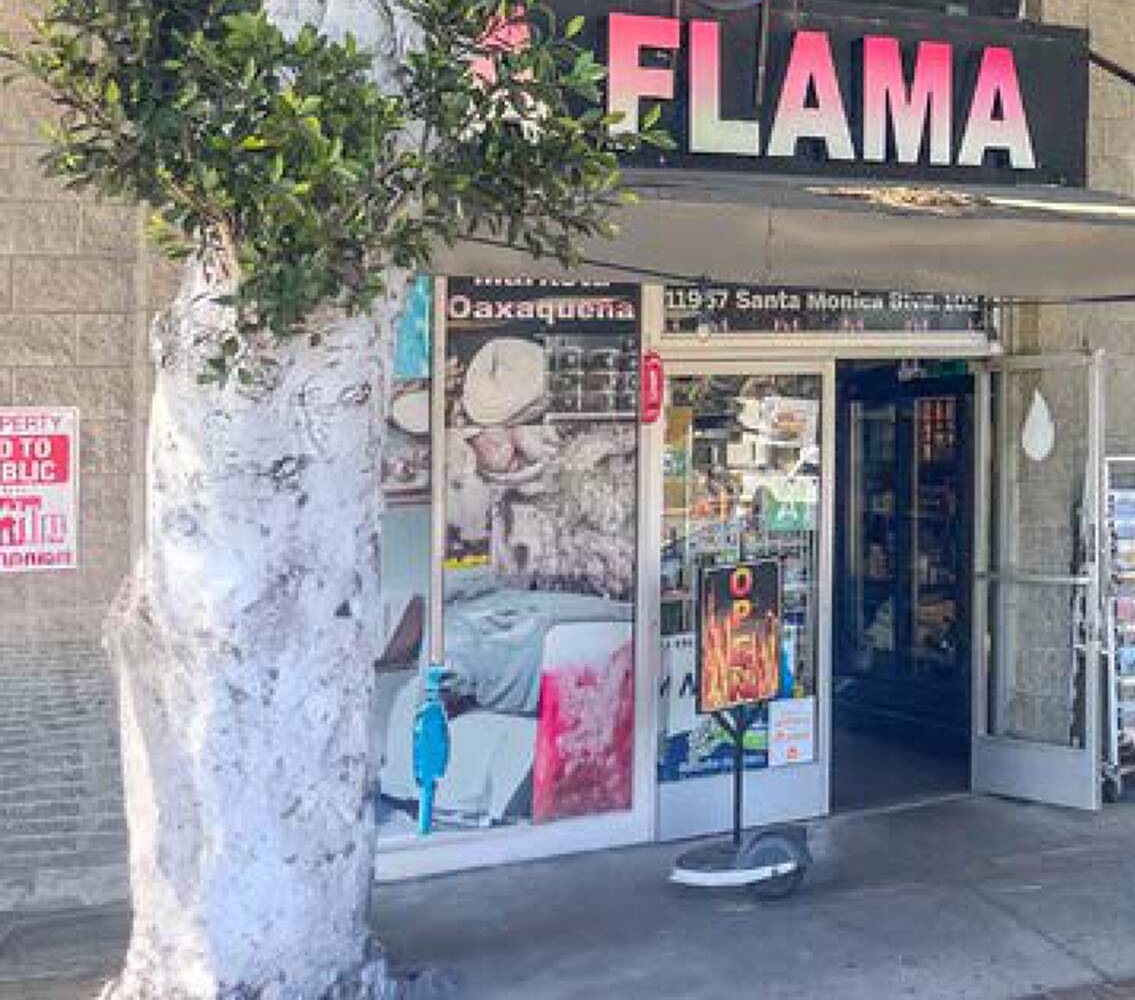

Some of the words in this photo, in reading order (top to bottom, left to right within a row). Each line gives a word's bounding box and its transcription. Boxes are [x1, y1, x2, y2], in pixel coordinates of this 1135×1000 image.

[607, 11, 1037, 171] FLAMA
[735, 288, 801, 310] Santa
[804, 289, 884, 311] Monica
[20, 438, 52, 459] TO
